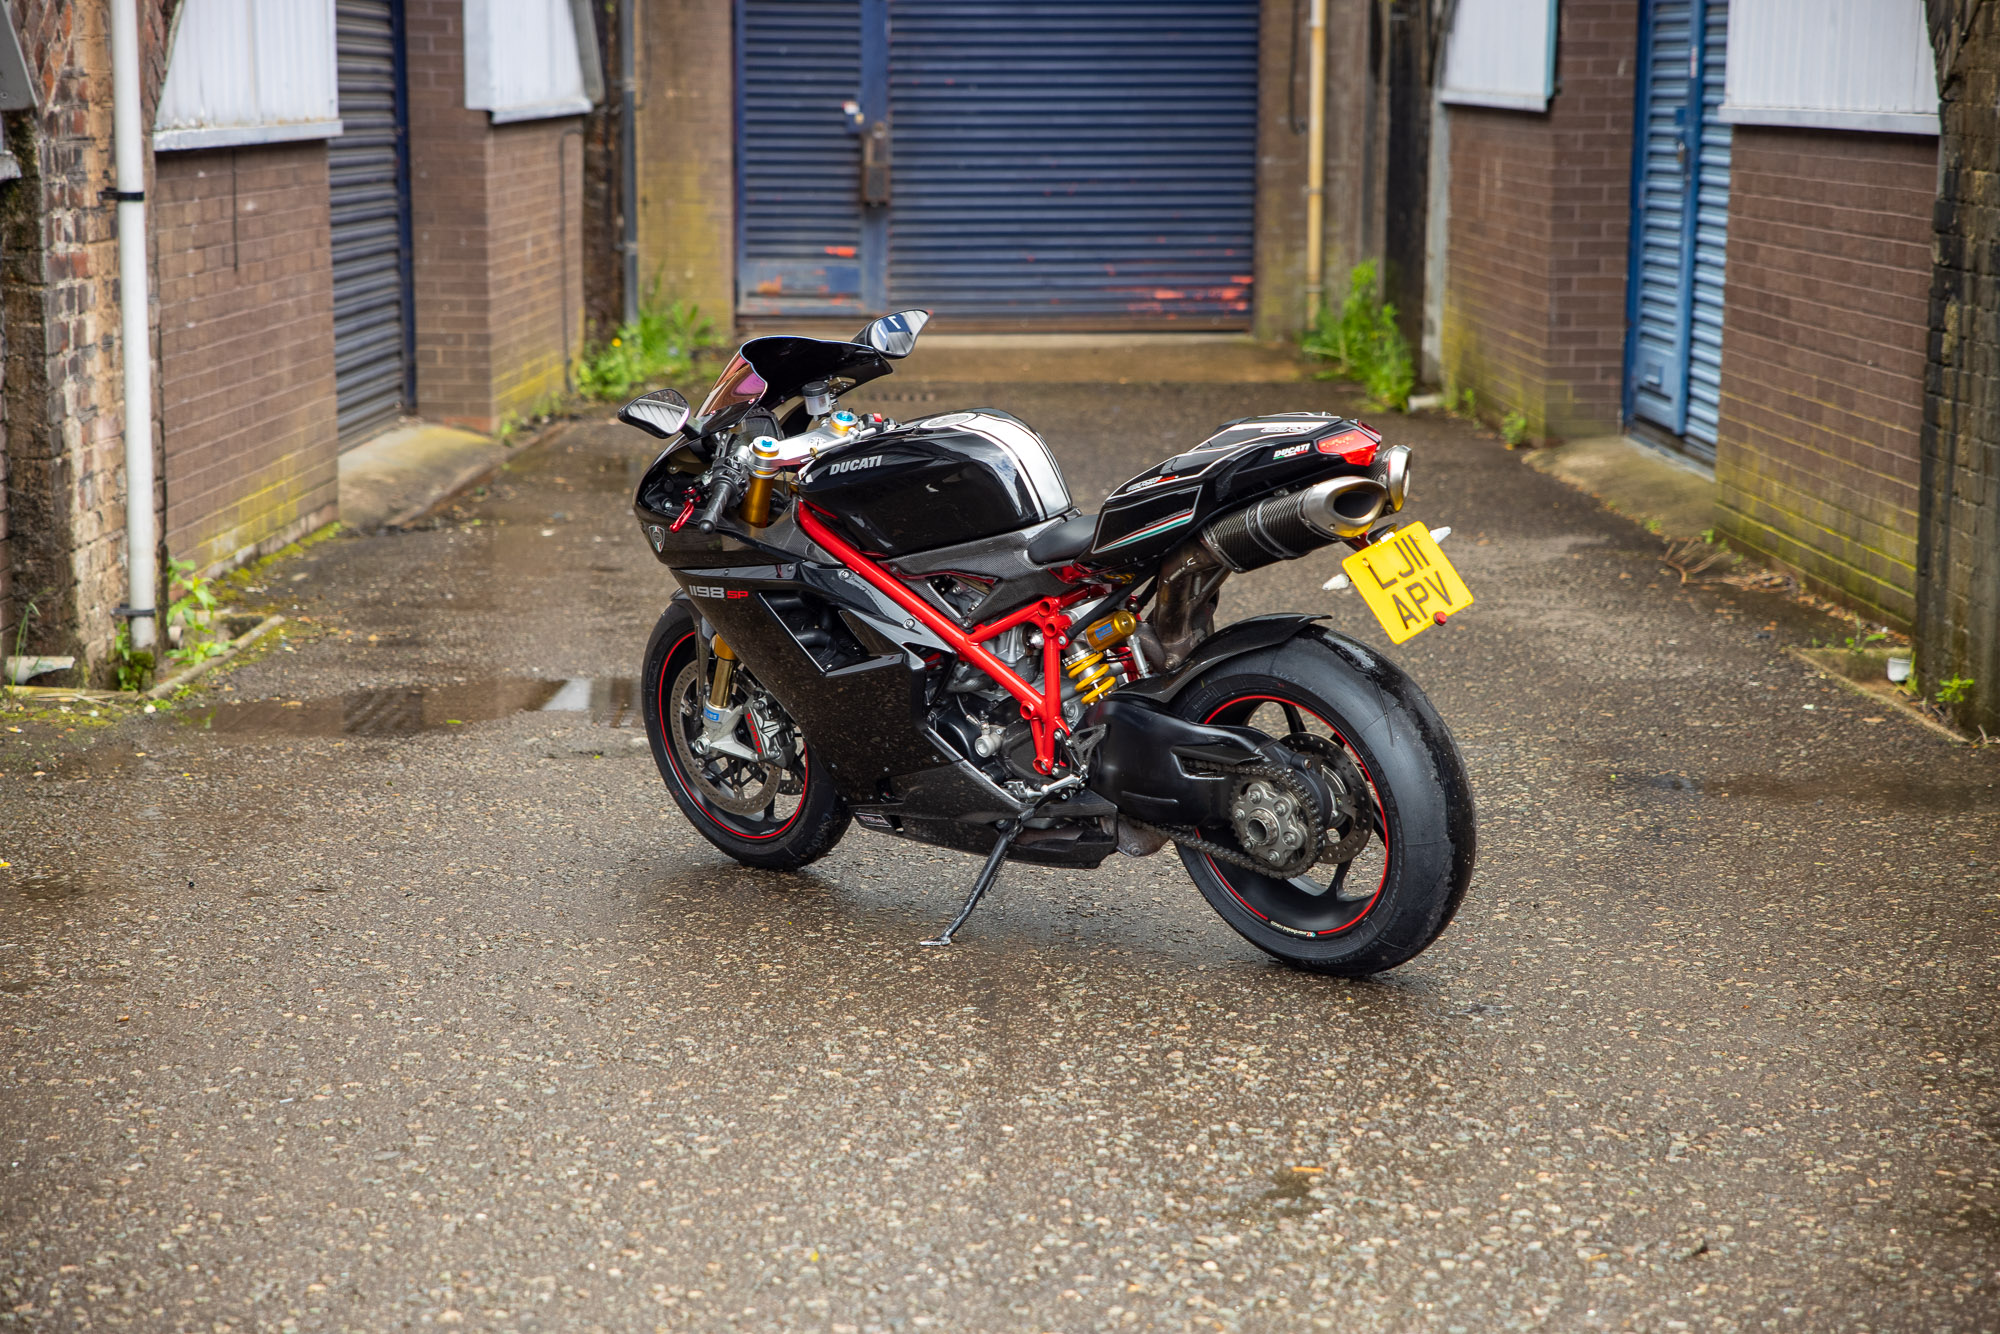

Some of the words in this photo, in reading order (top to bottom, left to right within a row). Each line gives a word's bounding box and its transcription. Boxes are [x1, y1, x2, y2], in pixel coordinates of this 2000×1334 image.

[1273, 442, 1311, 458] DUCATI
[829, 455, 883, 475] DUCATI
[1362, 534, 1431, 590] LJ11
[688, 584, 725, 599] 1198
[726, 590, 749, 599] SP
[1392, 571, 1453, 630] APV
